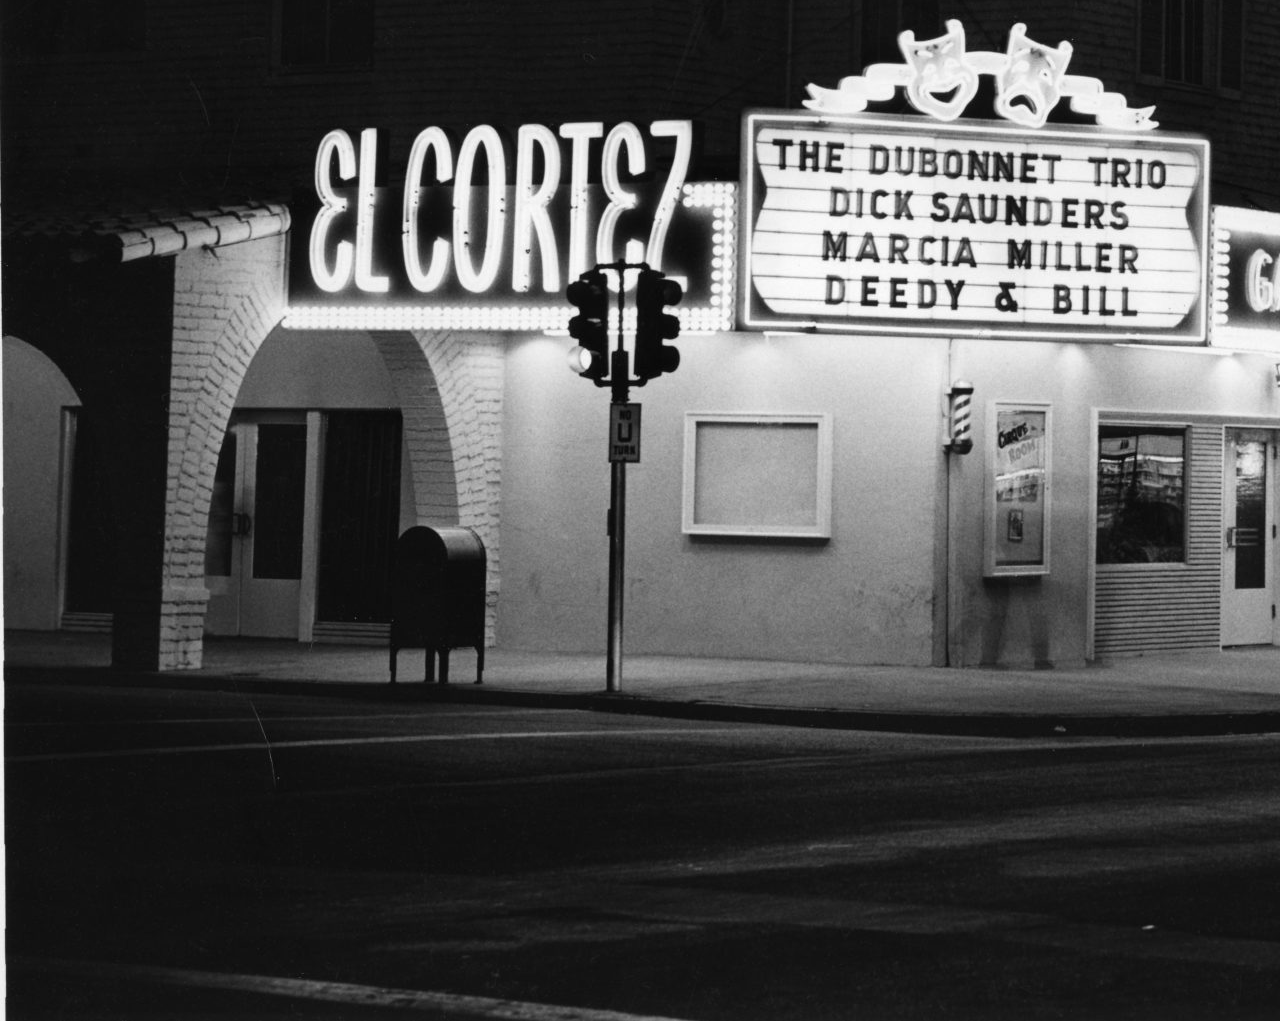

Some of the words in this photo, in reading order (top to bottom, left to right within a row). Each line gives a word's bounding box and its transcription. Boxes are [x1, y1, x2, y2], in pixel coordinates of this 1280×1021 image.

[771, 138, 846, 175] THE
[868, 145, 1060, 185] DUBONNET
[1088, 156, 1168, 190] TRIO
[308, 127, 390, 294] EL
[402, 120, 695, 294] CORTEZ
[828, 187, 921, 222] DICK
[931, 191, 1131, 230] SAUNDERS
[821, 232, 979, 268] MARCIA
[1007, 238, 1140, 275] MILLER
[826, 275, 964, 312] DEEDY
[996, 280, 1020, 314] &
[1053, 283, 1138, 317] BILL
[617, 423, 632, 442] U
[619, 410, 632, 420] NO
[613, 445, 636, 455] TURN
